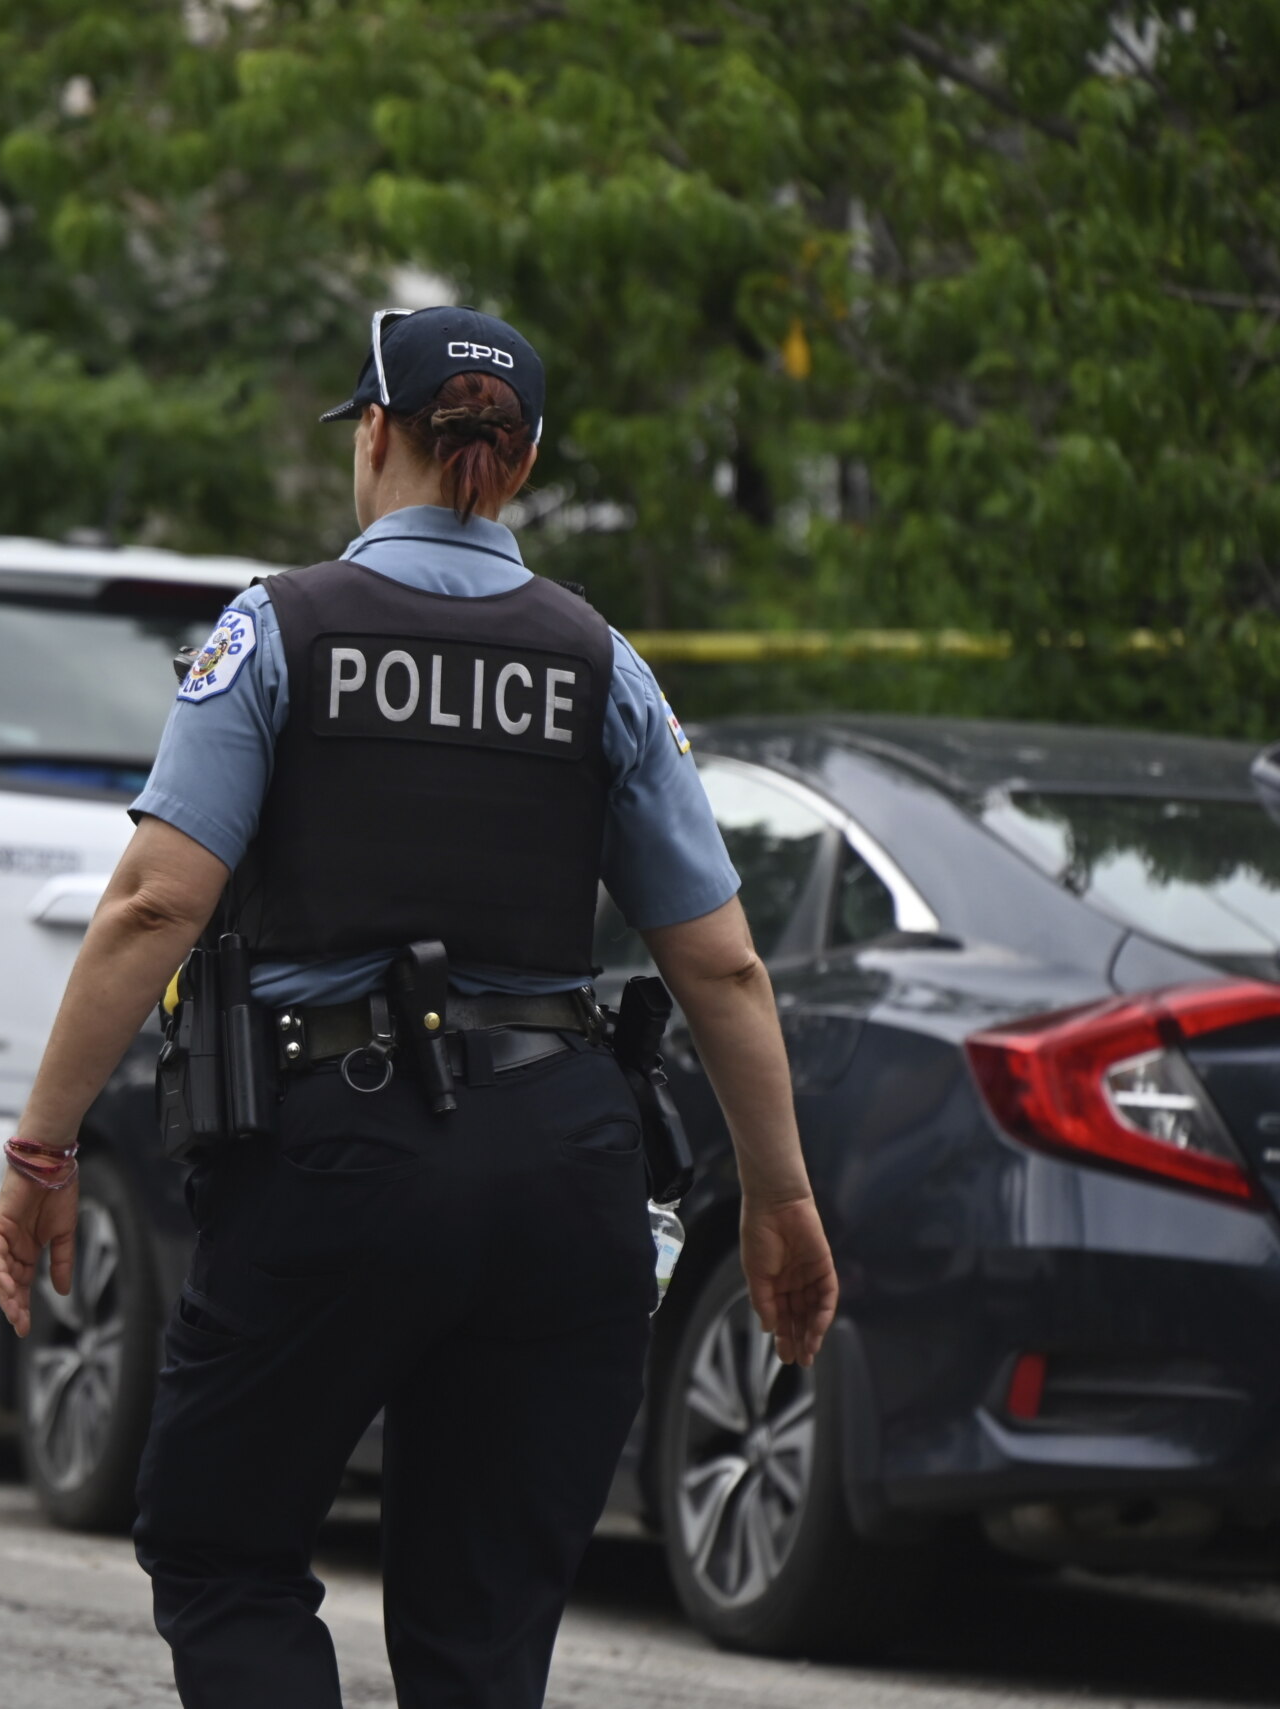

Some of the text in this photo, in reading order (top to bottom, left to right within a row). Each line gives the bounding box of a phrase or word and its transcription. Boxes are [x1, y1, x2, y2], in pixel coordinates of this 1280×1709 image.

[448, 341, 514, 368] CPD
[219, 614, 245, 655] CAGO
[329, 648, 576, 743] POLICE
